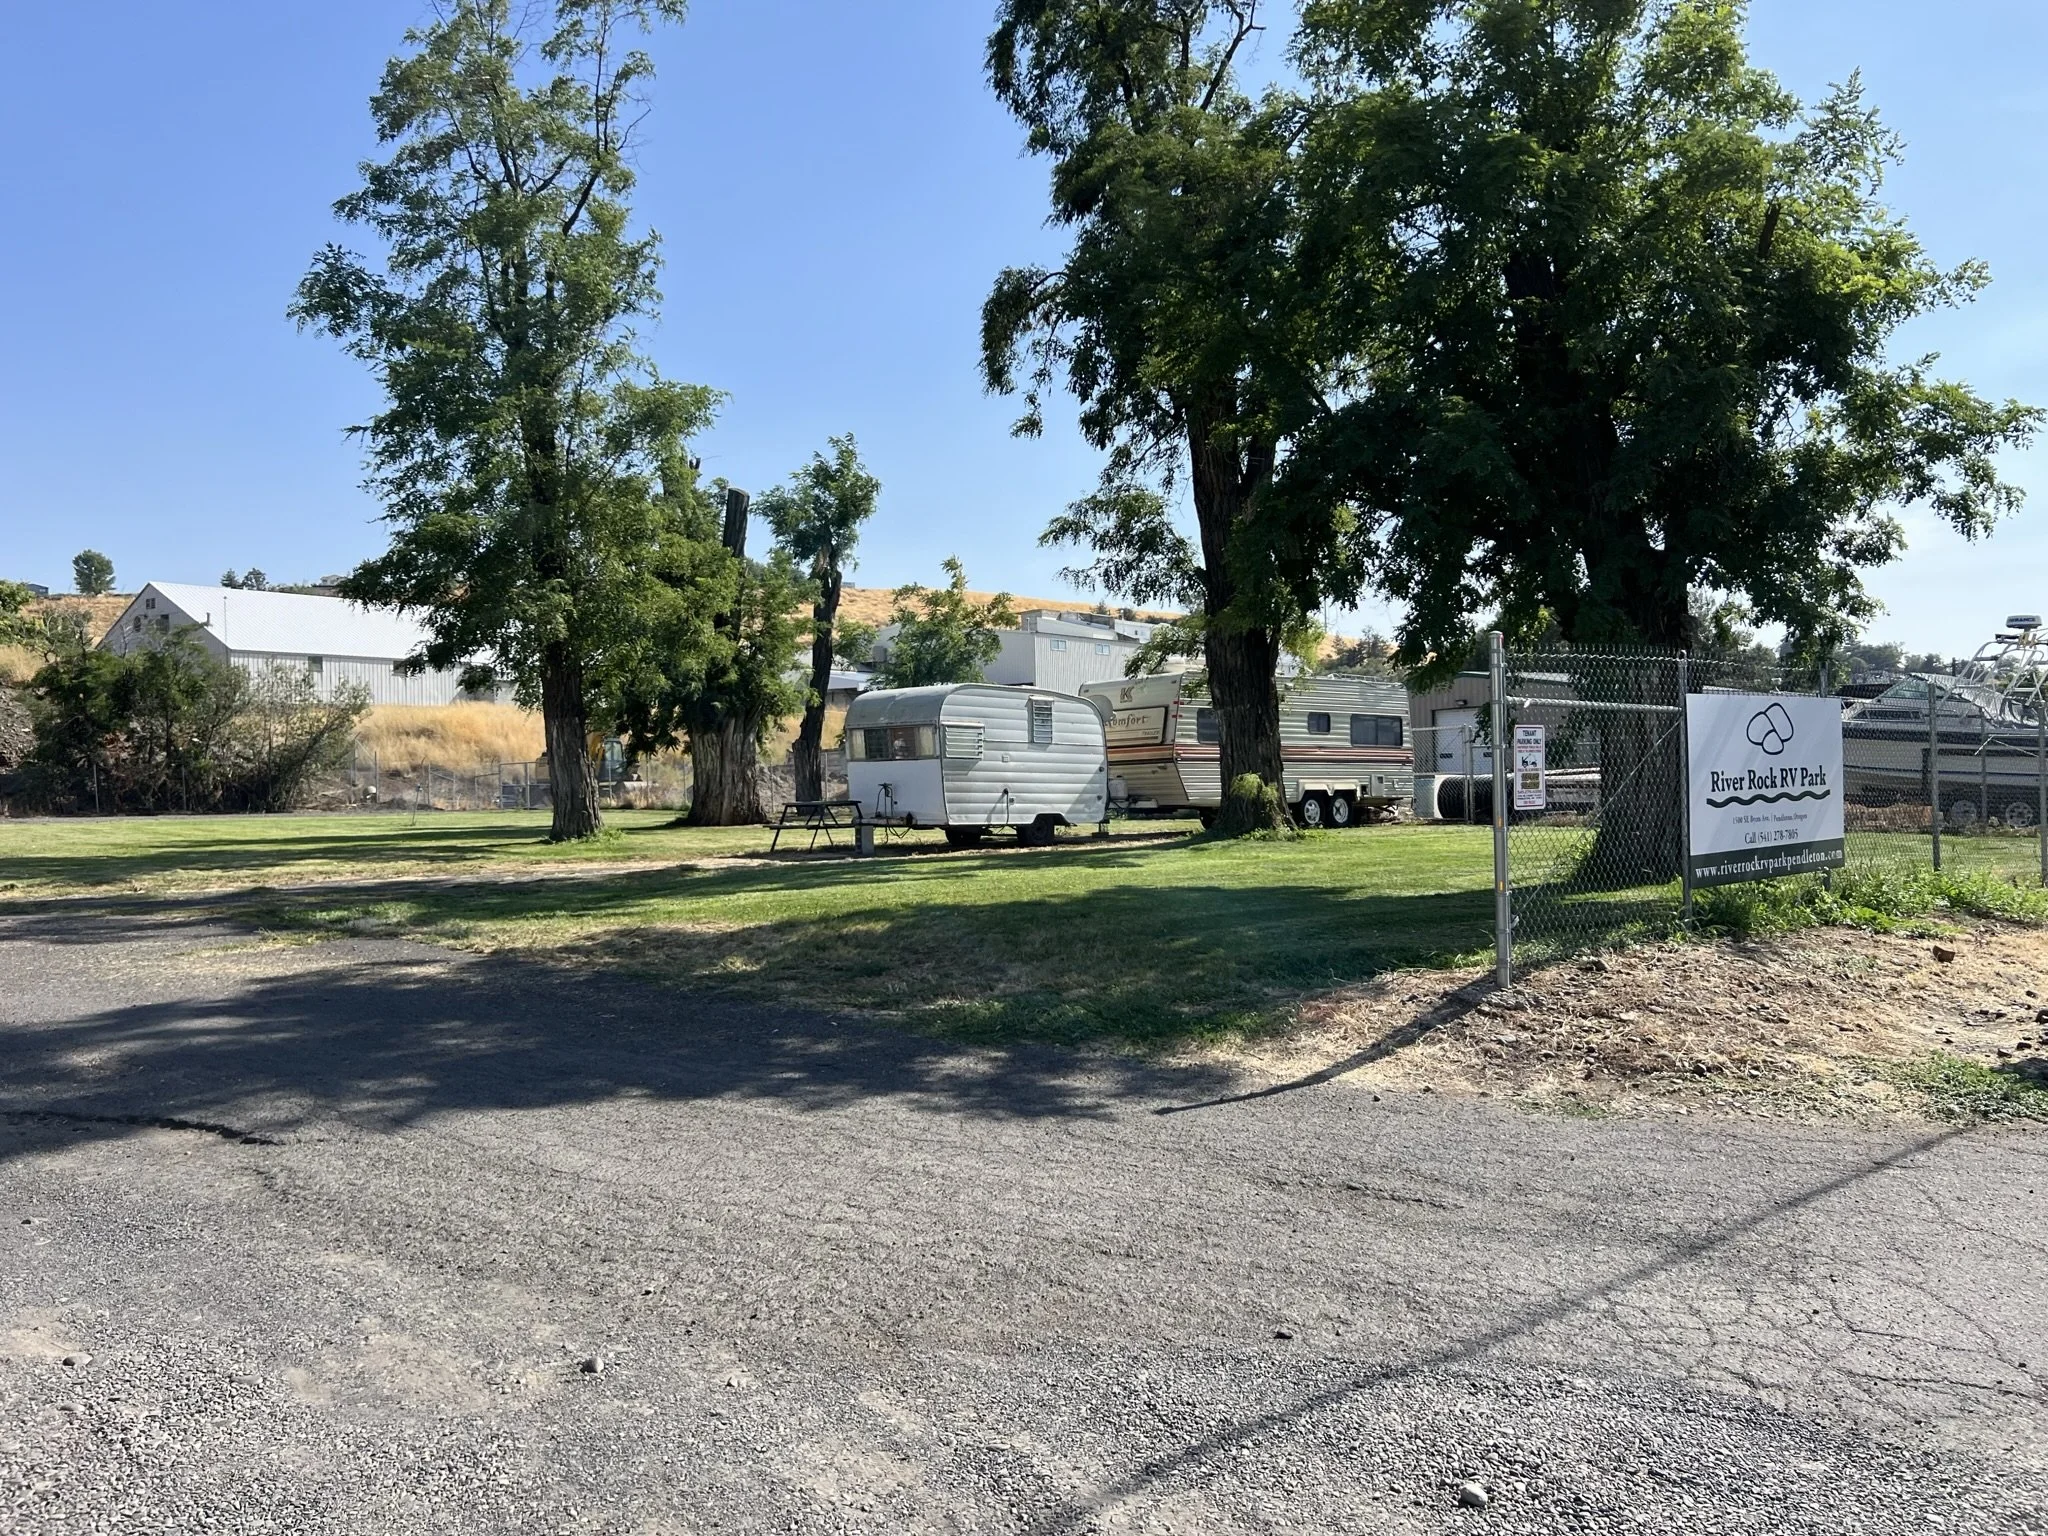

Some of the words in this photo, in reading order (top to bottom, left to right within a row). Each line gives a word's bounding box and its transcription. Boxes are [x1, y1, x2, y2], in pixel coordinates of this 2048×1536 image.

[1710, 770, 1745, 793] River
[1747, 767, 1778, 790] Rock
[1780, 767, 1798, 788] RV
[1800, 765, 1826, 787] Park
[1744, 832, 1757, 844] Call
[1757, 831, 1772, 844] (541)
[1695, 849, 1843, 878] www.riverrockrvparkpendleton.com
